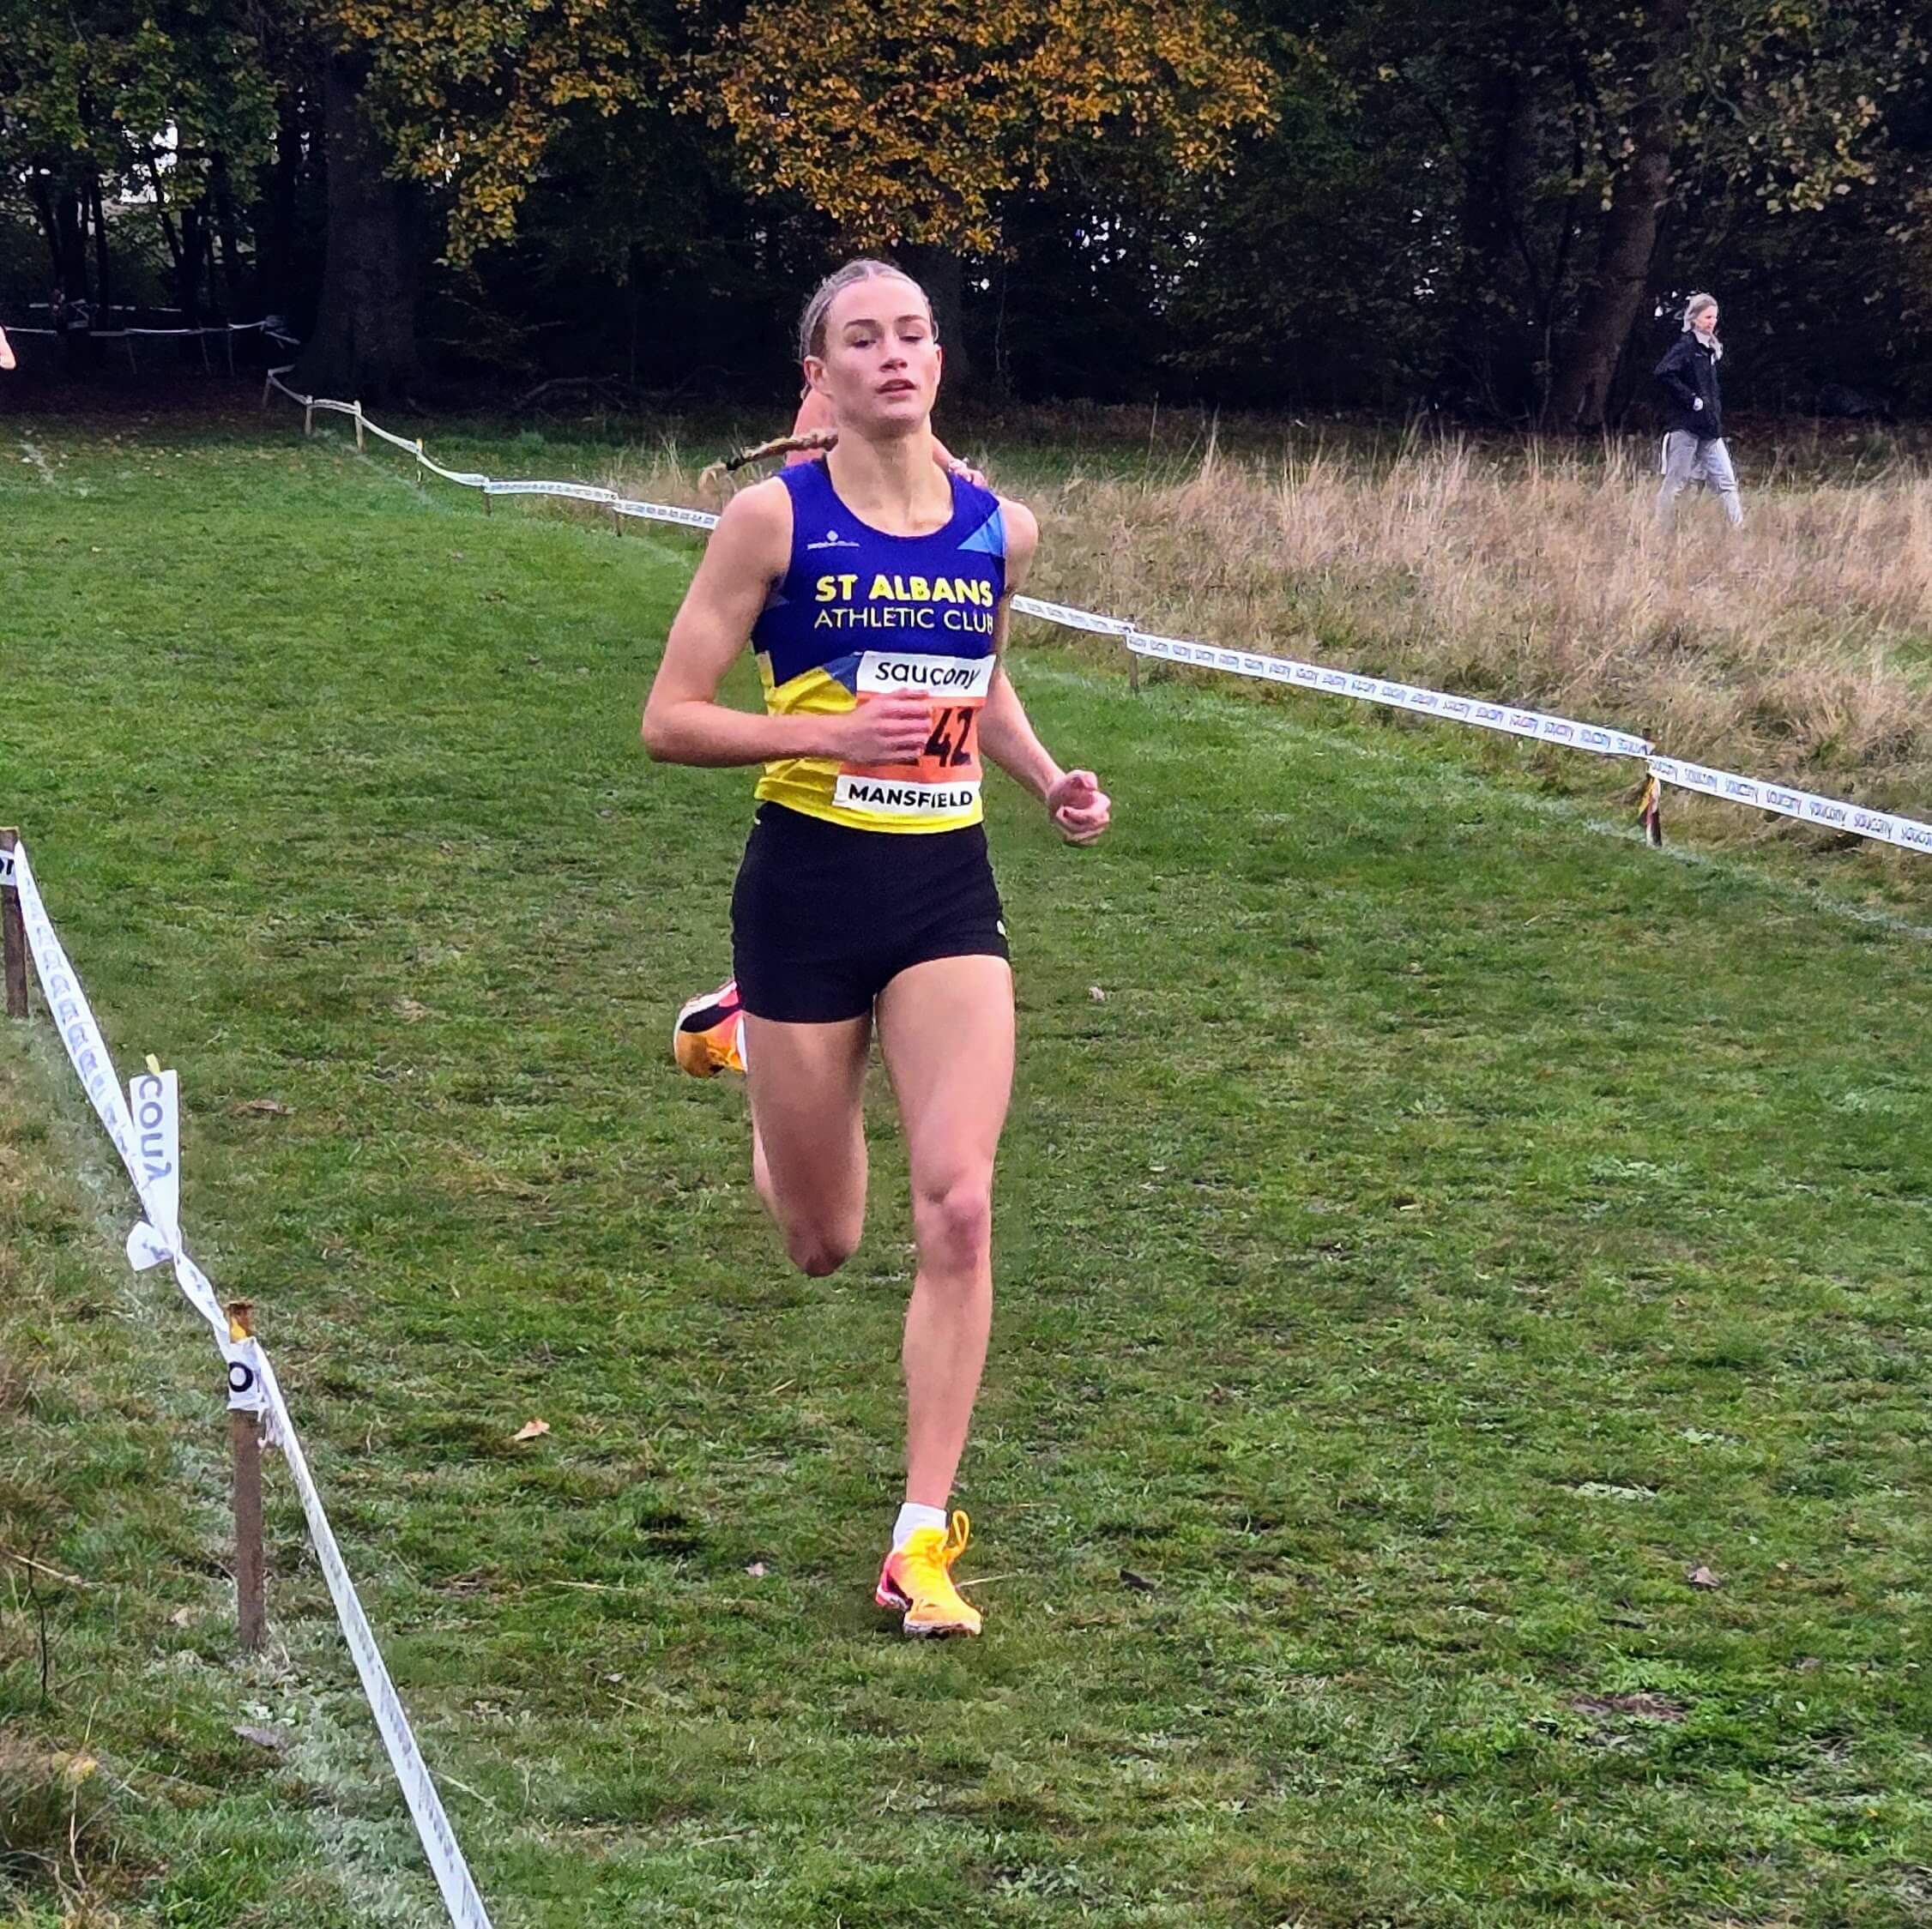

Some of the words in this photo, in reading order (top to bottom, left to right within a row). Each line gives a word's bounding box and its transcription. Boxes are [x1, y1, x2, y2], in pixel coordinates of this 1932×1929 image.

[815, 575, 858, 602] ST
[869, 575, 993, 607] ALBANS
[814, 606, 934, 629] ATHLETIC
[944, 610, 993, 636] CLUB
[875, 661, 980, 690] saucony
[848, 782, 972, 809] MANSFIELD
